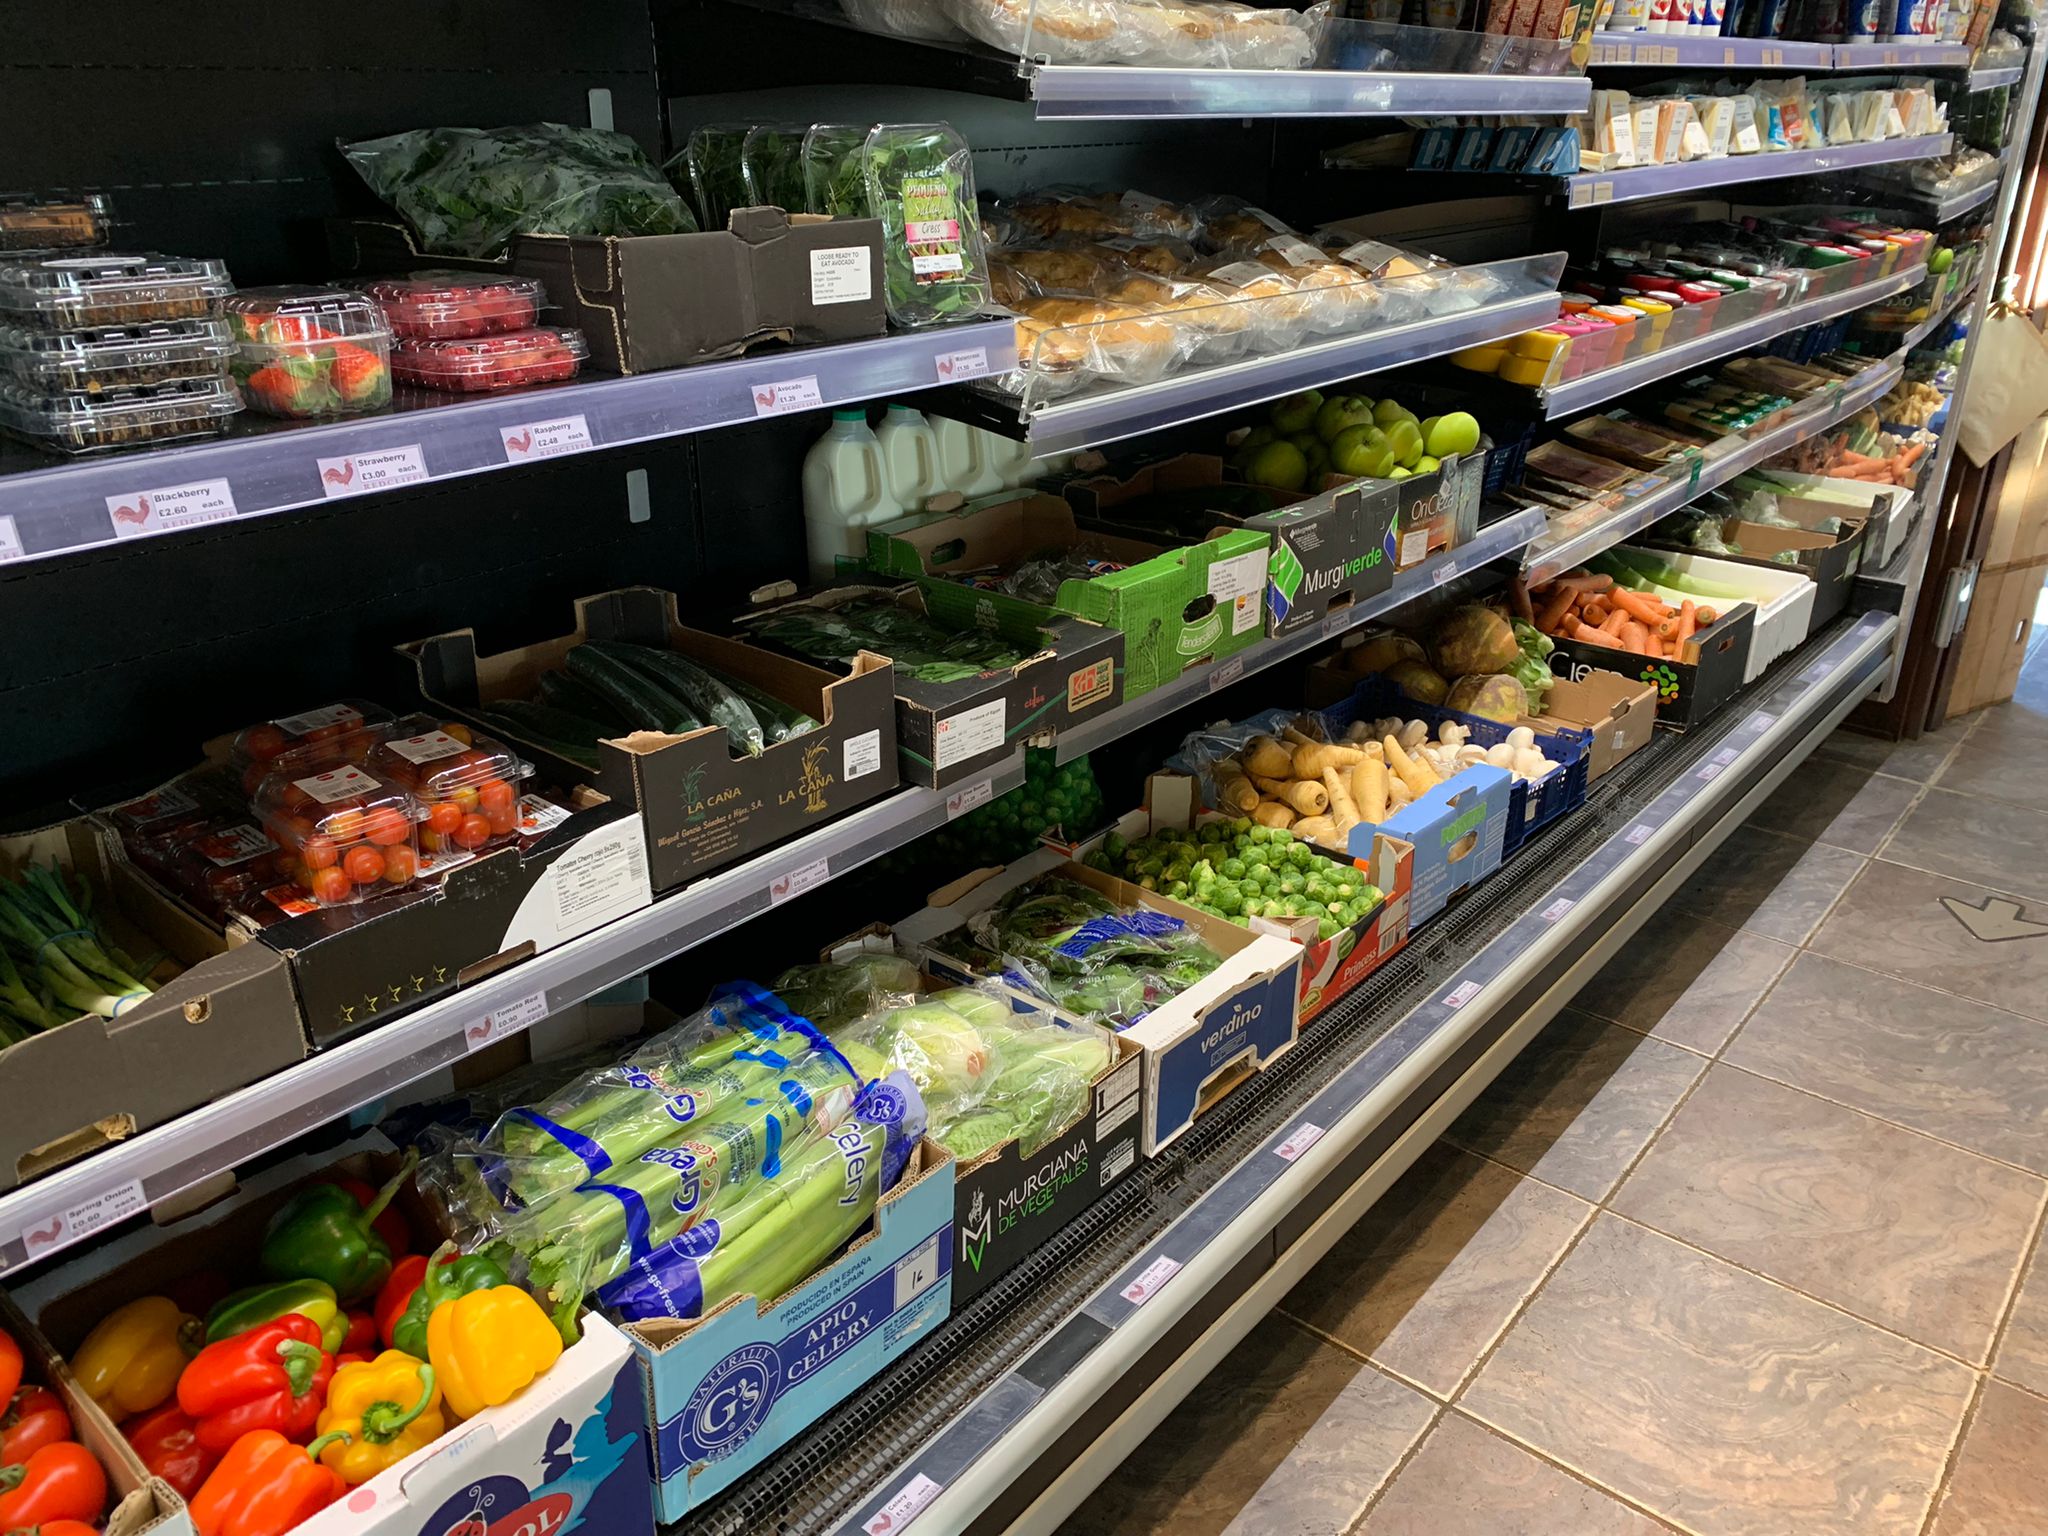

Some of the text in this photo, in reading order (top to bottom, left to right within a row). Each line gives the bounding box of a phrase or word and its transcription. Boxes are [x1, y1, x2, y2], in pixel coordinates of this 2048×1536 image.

[921, 222, 941, 234] Cress
[778, 384, 802, 392] Avocado
[534, 423, 571, 434] Raspberry
[538, 432, 584, 447] £2.48 each
[358, 453, 406, 467] Strawberry
[362, 465, 416, 480] £3.00 each
[154, 488, 210, 503] Blackberry
[159, 499, 224, 517] £2.60 each
[1304, 546, 1382, 595] Murgiverde
[687, 787, 742, 815] LA CAÑA
[778, 790, 796, 806] LA
[577, 853, 594, 863] Cherry
[1344, 948, 1377, 980] Princess
[497, 995, 538, 1018] Tomato Red
[498, 1015, 518, 1028] £0.90
[527, 1004, 542, 1014] each
[1201, 1004, 1262, 1054] verdino
[870, 1098, 892, 1119] G's
[640, 1147, 702, 1214] Grega
[998, 1138, 1088, 1218] MURCIANA
[69, 1186, 134, 1218] Spring Onion
[999, 1208, 1018, 1235] DE
[1020, 1156, 1088, 1218] VEGETALES
[72, 1212, 100, 1230] £0.60
[780, 1255, 872, 1323] PRODUCIDO EN ESPAÑA
[786, 1269, 865, 1327] PRODUCED IN SPAIN
[804, 1300, 857, 1349] APIO
[787, 1309, 873, 1380] CELERY
[688, 1348, 772, 1411] NATURALLY
[700, 1378, 760, 1434] G's
[888, 1494, 908, 1511] Celery
[896, 1501, 913, 1517] £1.20
